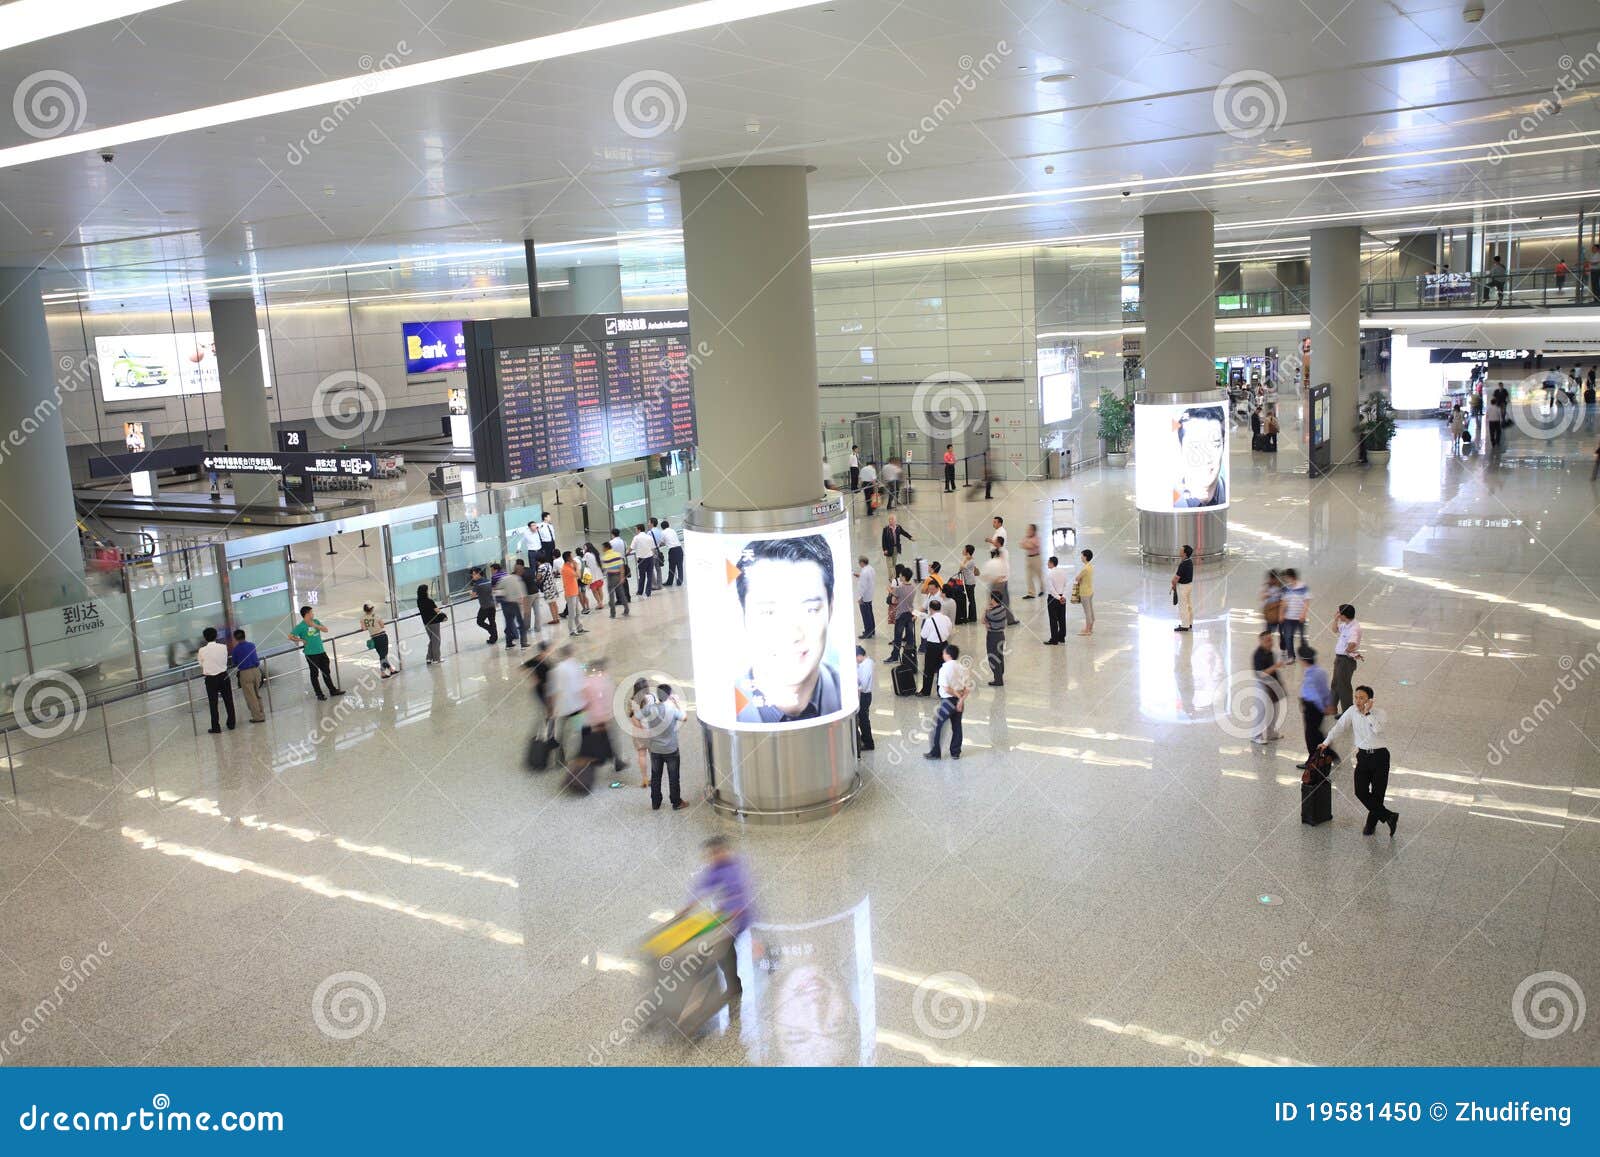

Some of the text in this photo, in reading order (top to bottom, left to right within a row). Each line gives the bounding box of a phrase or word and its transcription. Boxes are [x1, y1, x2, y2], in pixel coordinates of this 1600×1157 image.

[407, 335, 448, 360] Bank
[287, 432, 299, 445] 28
[63, 602, 99, 625] 到达
[65, 618, 105, 635] Arrivals
